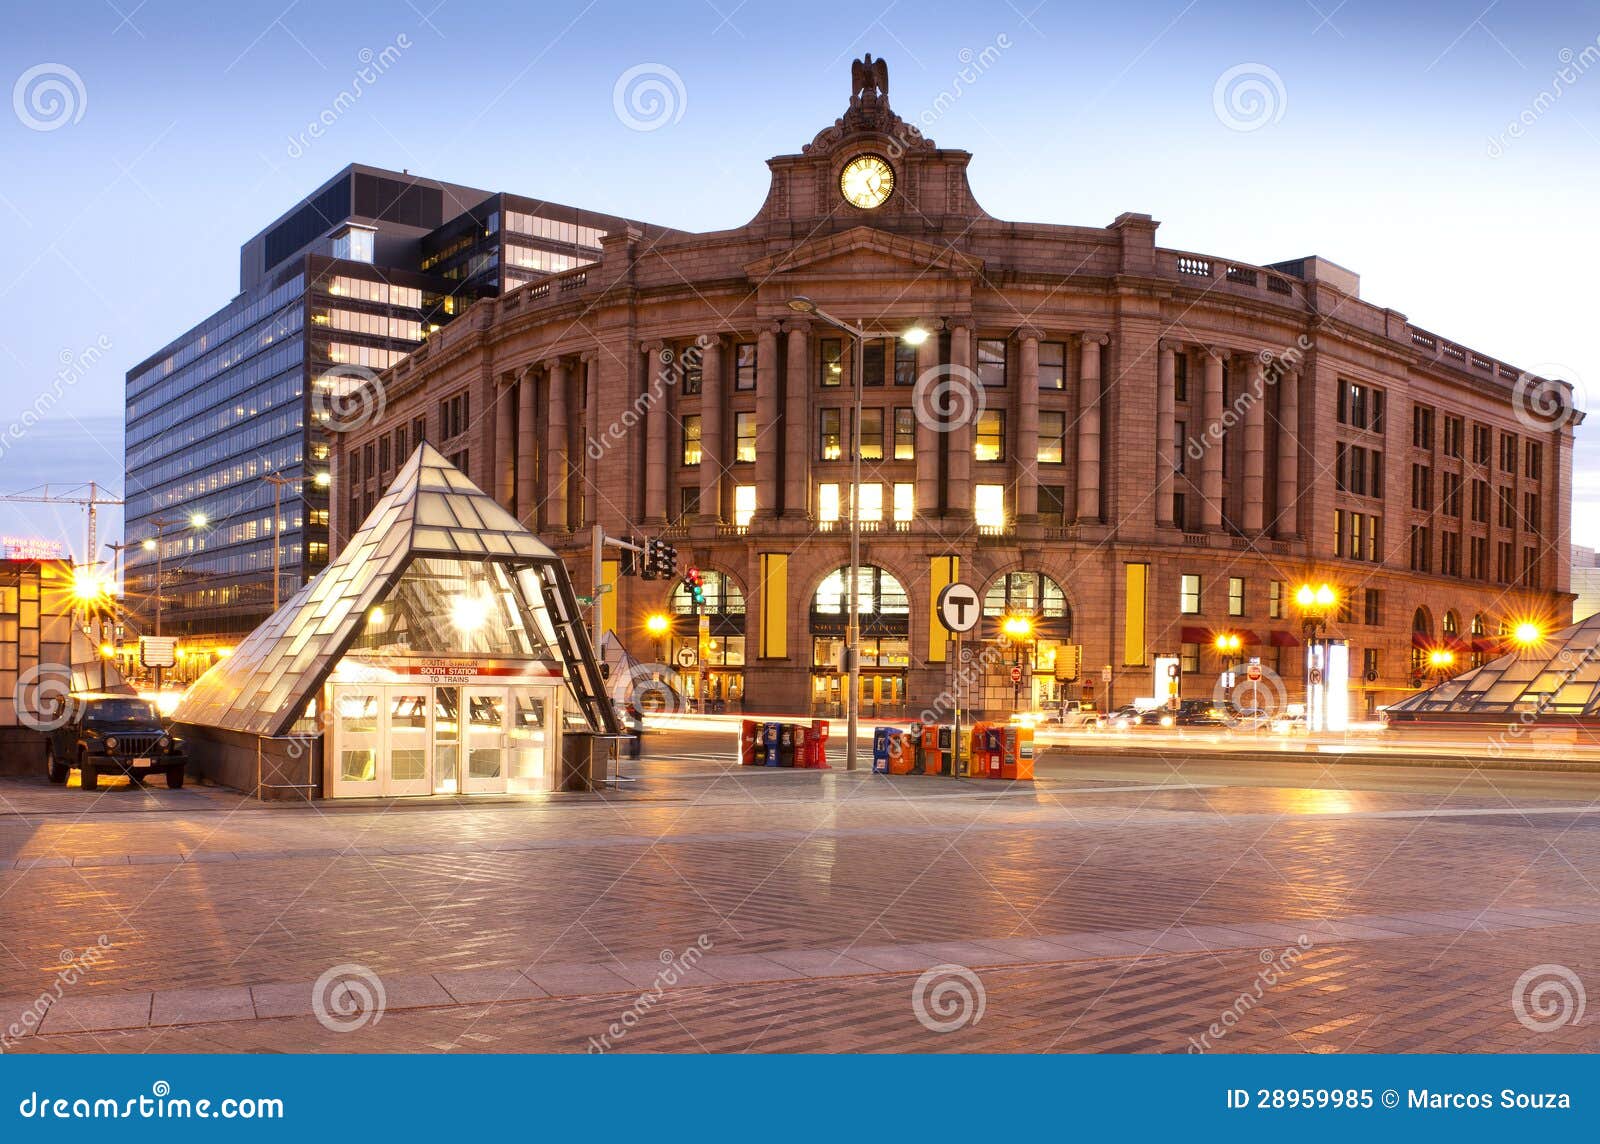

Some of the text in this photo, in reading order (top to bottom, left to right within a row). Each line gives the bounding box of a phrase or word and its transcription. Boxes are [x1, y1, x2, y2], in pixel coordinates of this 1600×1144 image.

[949, 596, 974, 625] T
[681, 653, 692, 664] T
[421, 667, 478, 675] SOUTH STATION
